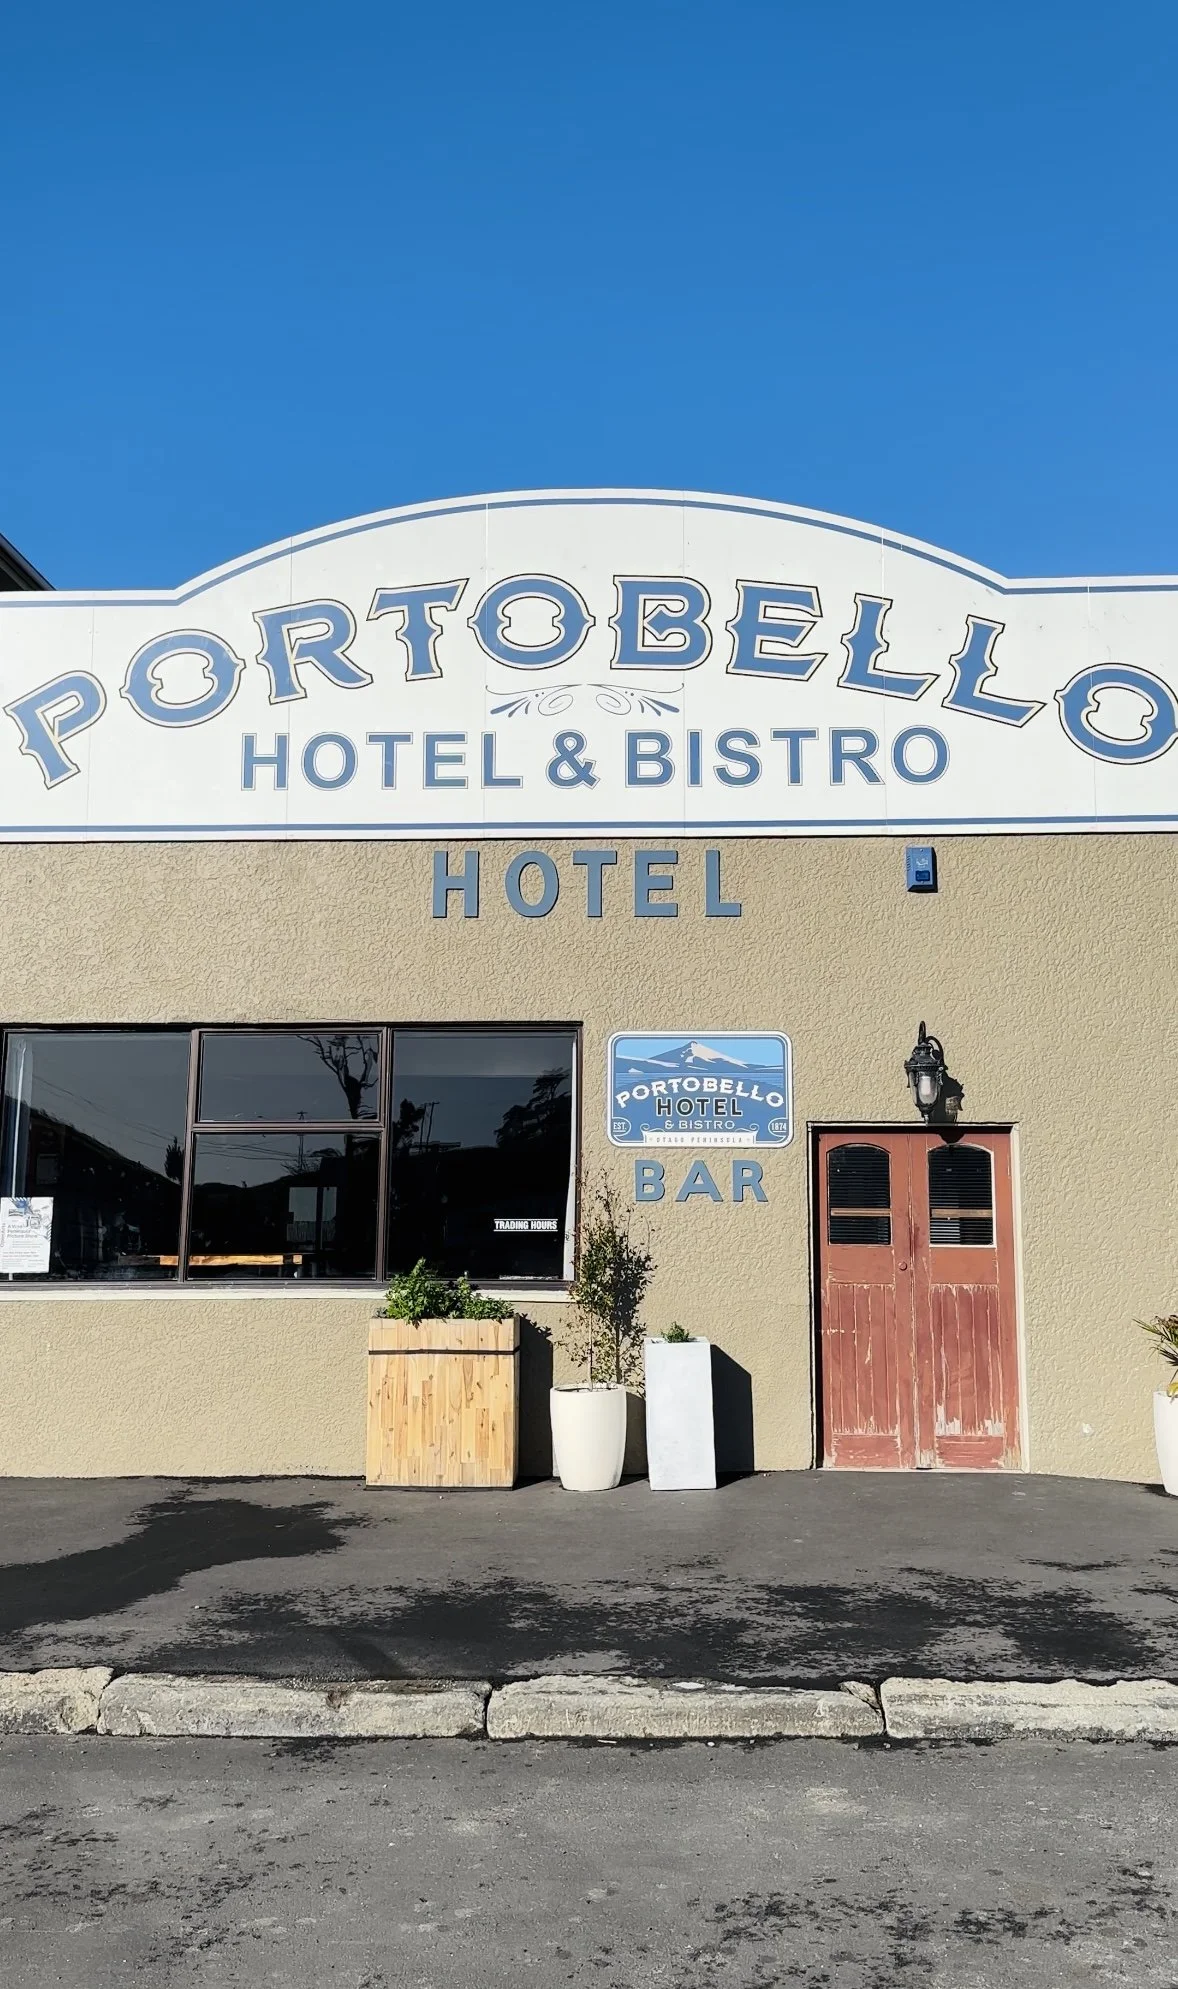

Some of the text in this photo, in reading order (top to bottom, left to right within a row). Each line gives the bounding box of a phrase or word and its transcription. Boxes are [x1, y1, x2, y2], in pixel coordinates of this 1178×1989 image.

[3, 572, 1178, 790] PORTOBELLO
[240, 724, 951, 791] HOTEL & BISTRO
[432, 849, 742, 918] HOTEL
[616, 1077, 784, 1108] PORTOBELLO
[656, 1096, 743, 1117] HOTEL
[613, 1122, 627, 1130] EST.
[664, 1120, 736, 1130] & BISTRO
[771, 1122, 787, 1131] 1874
[634, 1159, 769, 1203] BAR
[495, 1221, 557, 1229] TRADING HOURS
